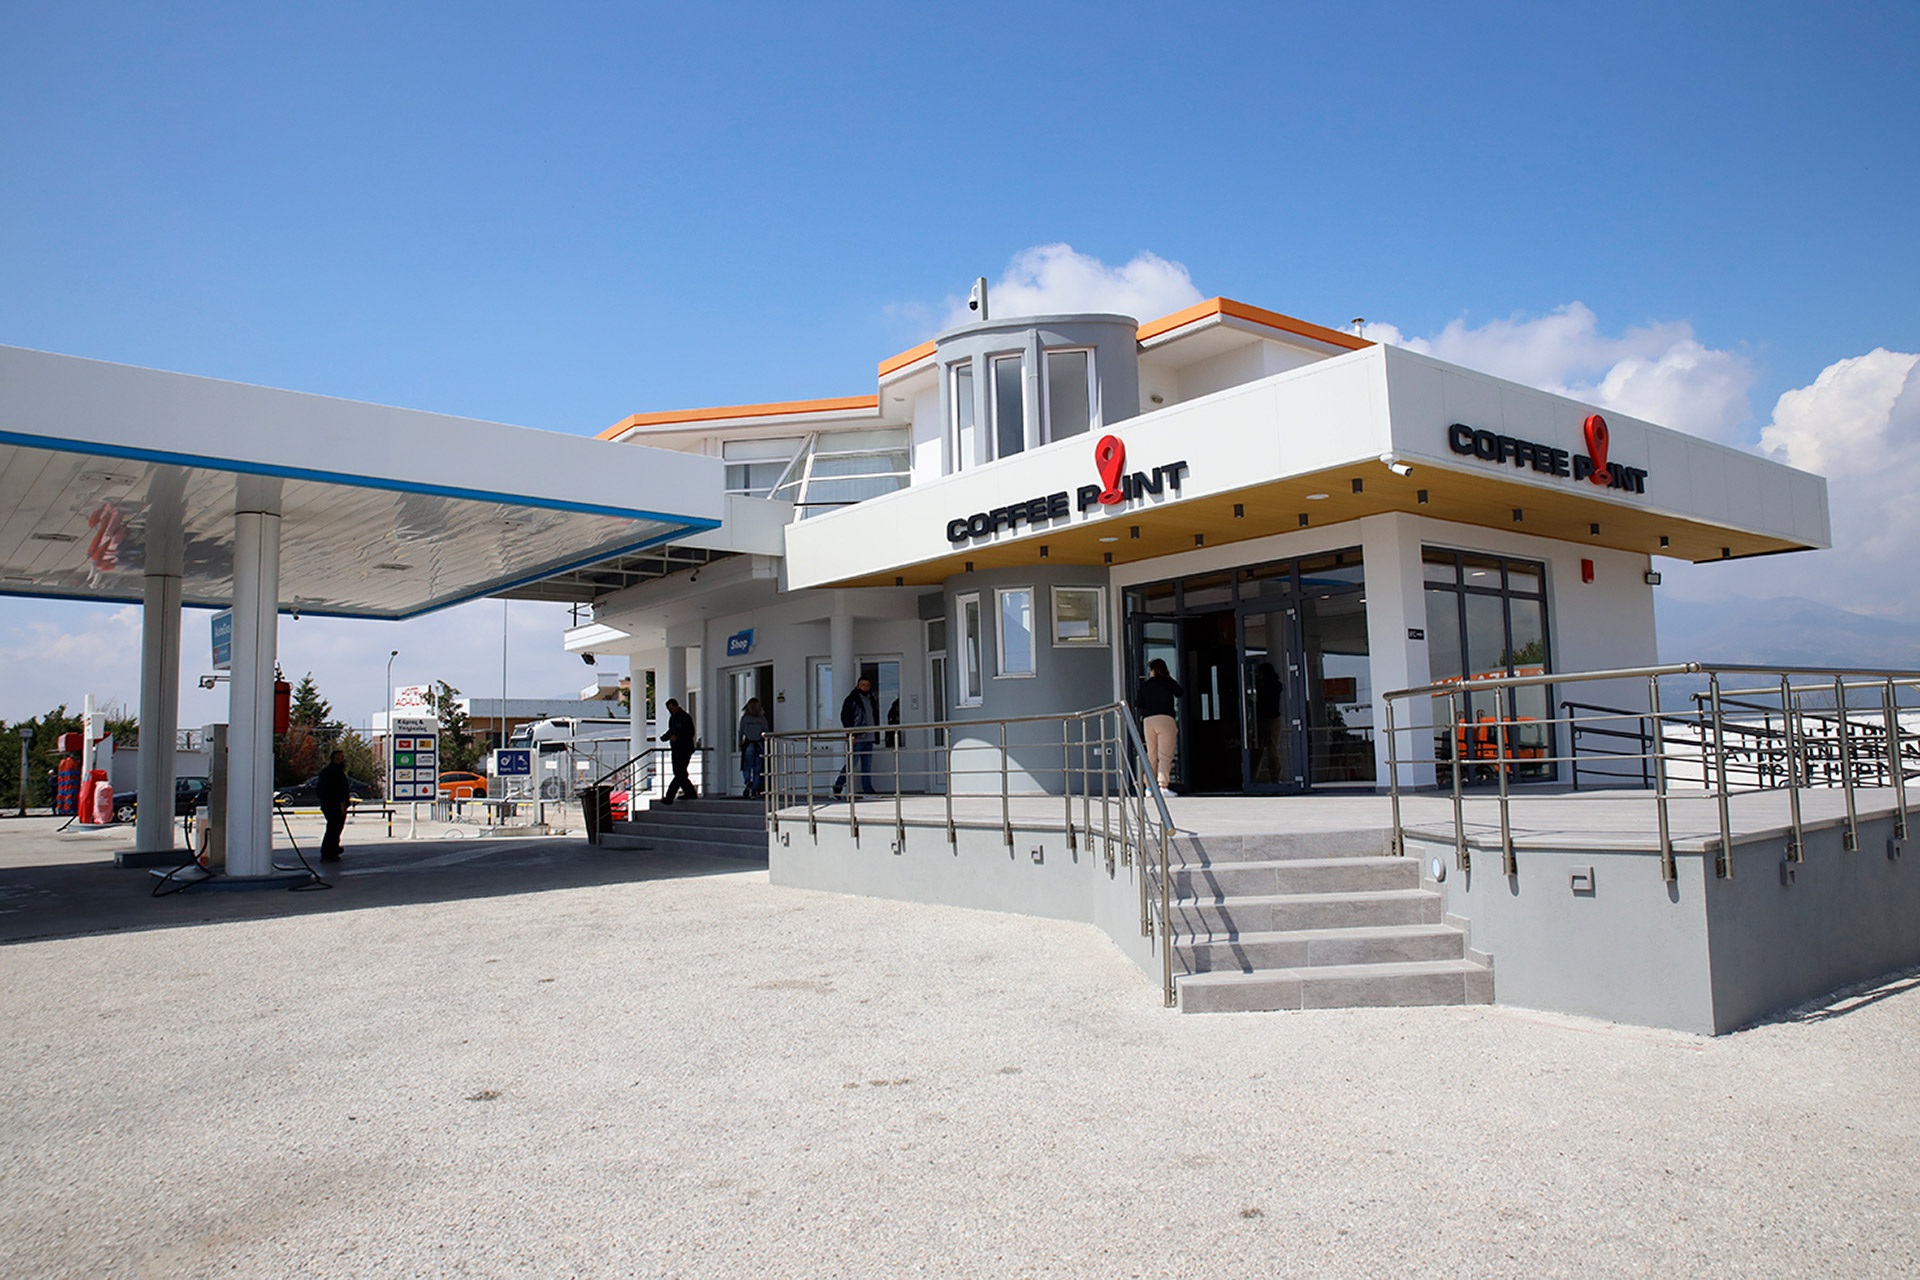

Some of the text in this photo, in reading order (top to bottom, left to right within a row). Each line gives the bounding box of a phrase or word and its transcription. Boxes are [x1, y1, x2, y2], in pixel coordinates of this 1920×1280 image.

[1449, 423, 1570, 478] COFFEE
[946, 491, 1071, 543] COFFEE
[730, 639, 748, 650] Shop
